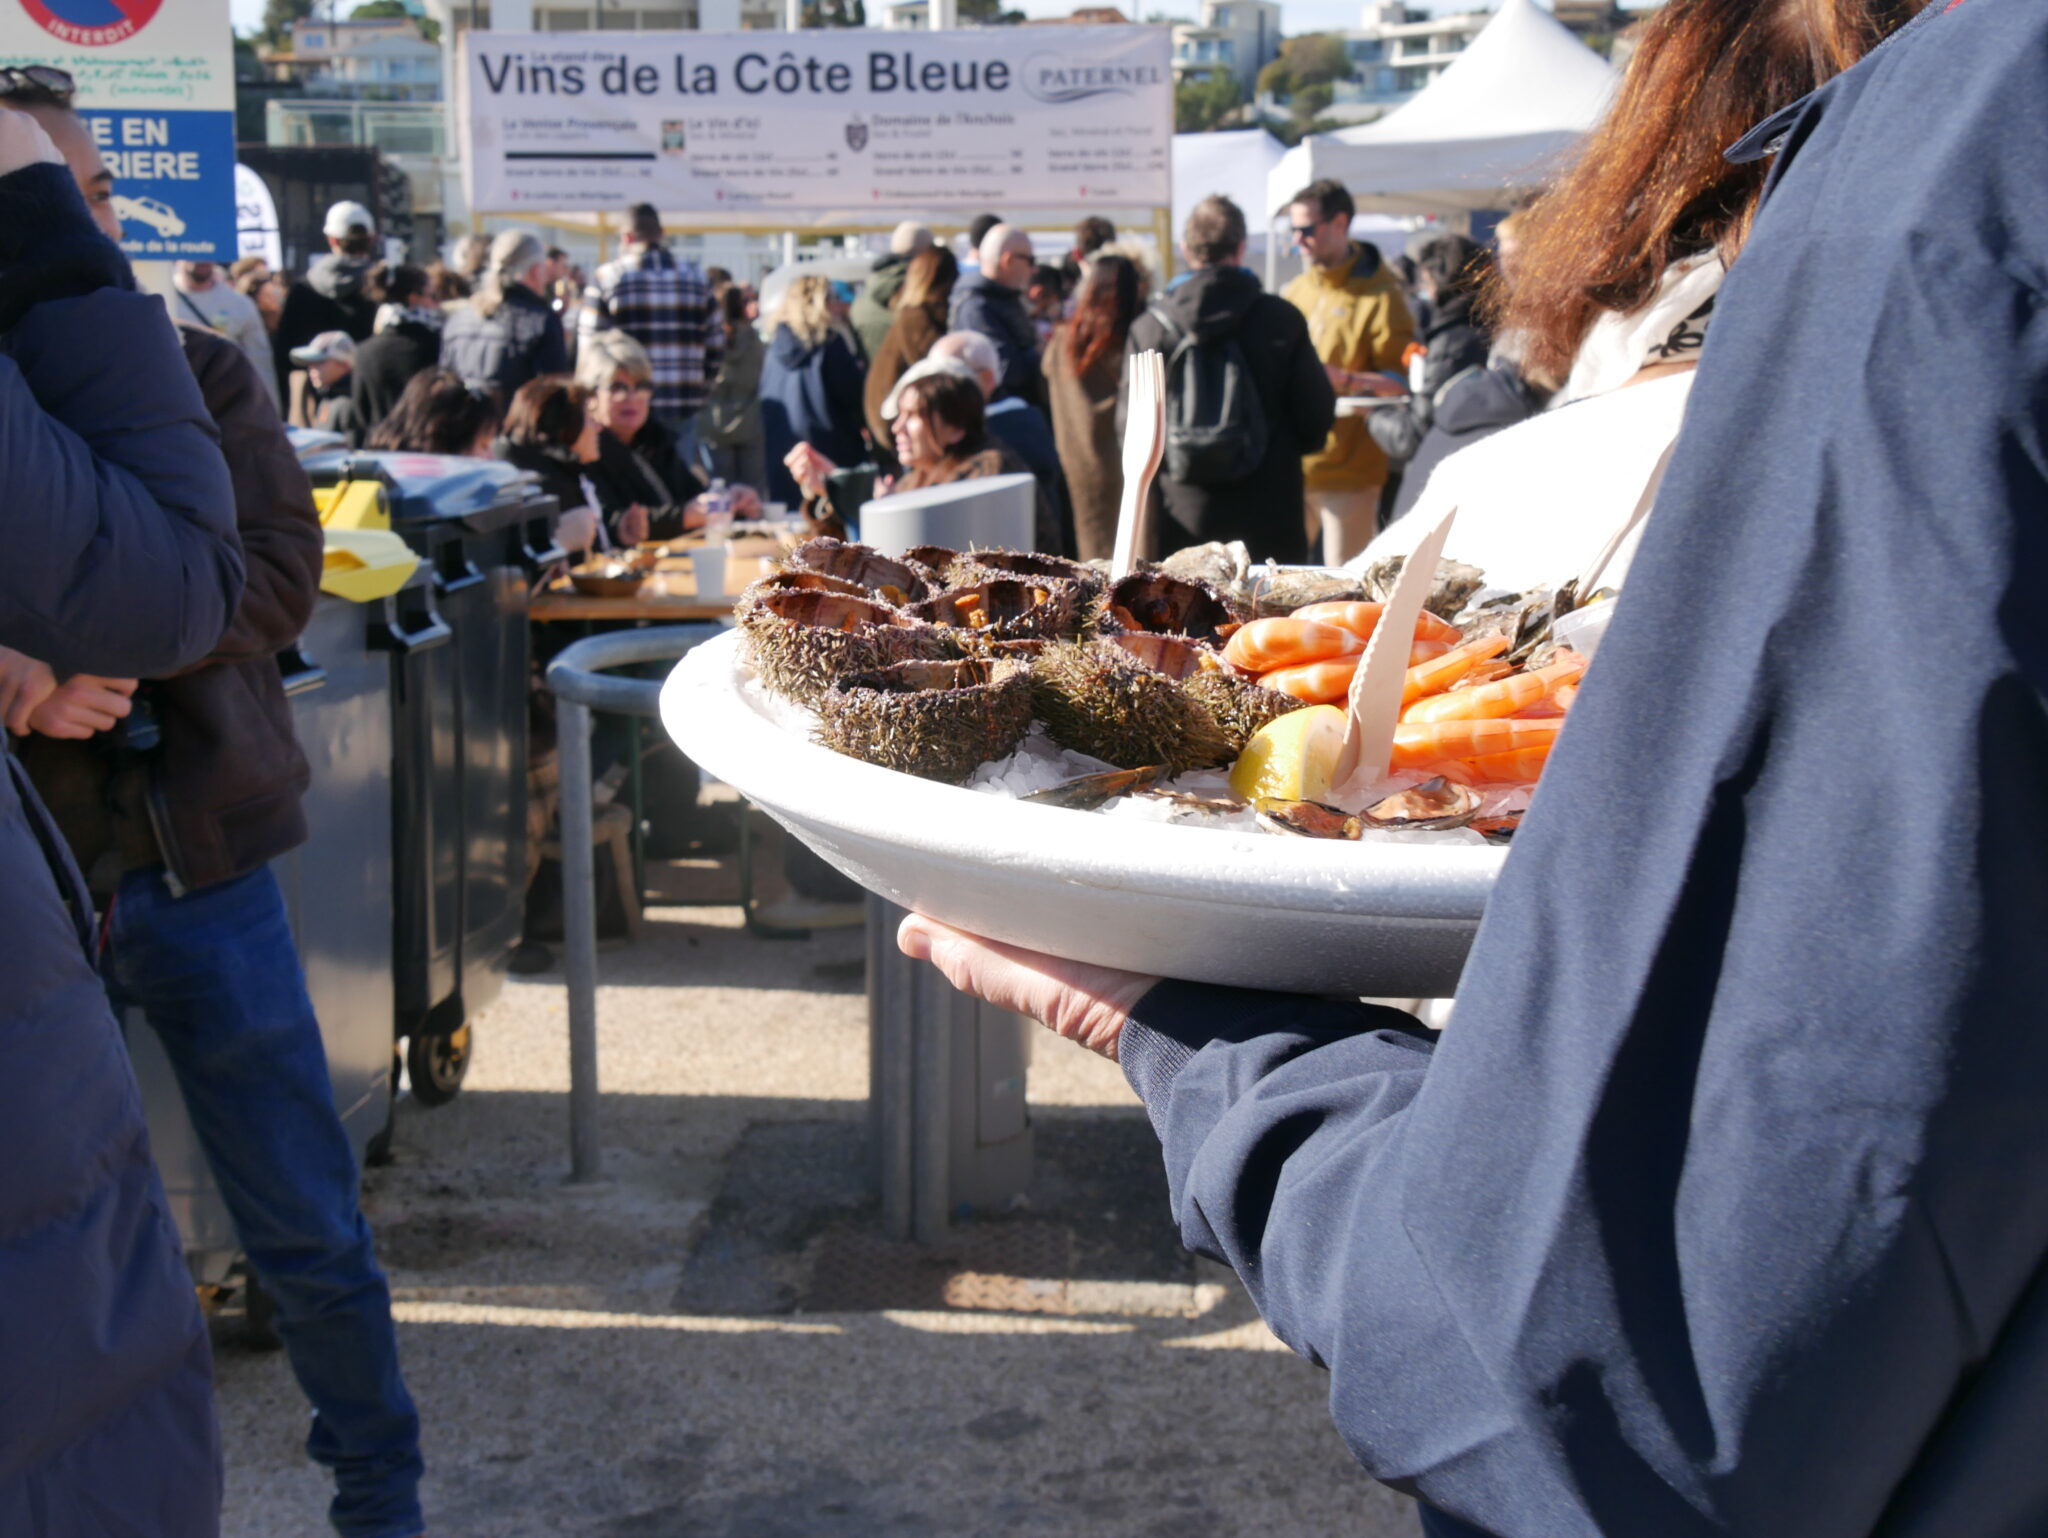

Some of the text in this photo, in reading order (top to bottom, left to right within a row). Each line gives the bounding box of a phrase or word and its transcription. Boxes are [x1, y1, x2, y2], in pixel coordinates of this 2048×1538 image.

[48, 18, 135, 45] INTERDIT
[479, 50, 1011, 96] Vins de la Côte Bleue
[1040, 66, 1162, 88] PATERNEL
[122, 118, 169, 147] EN
[119, 240, 215, 254] ode de la route
